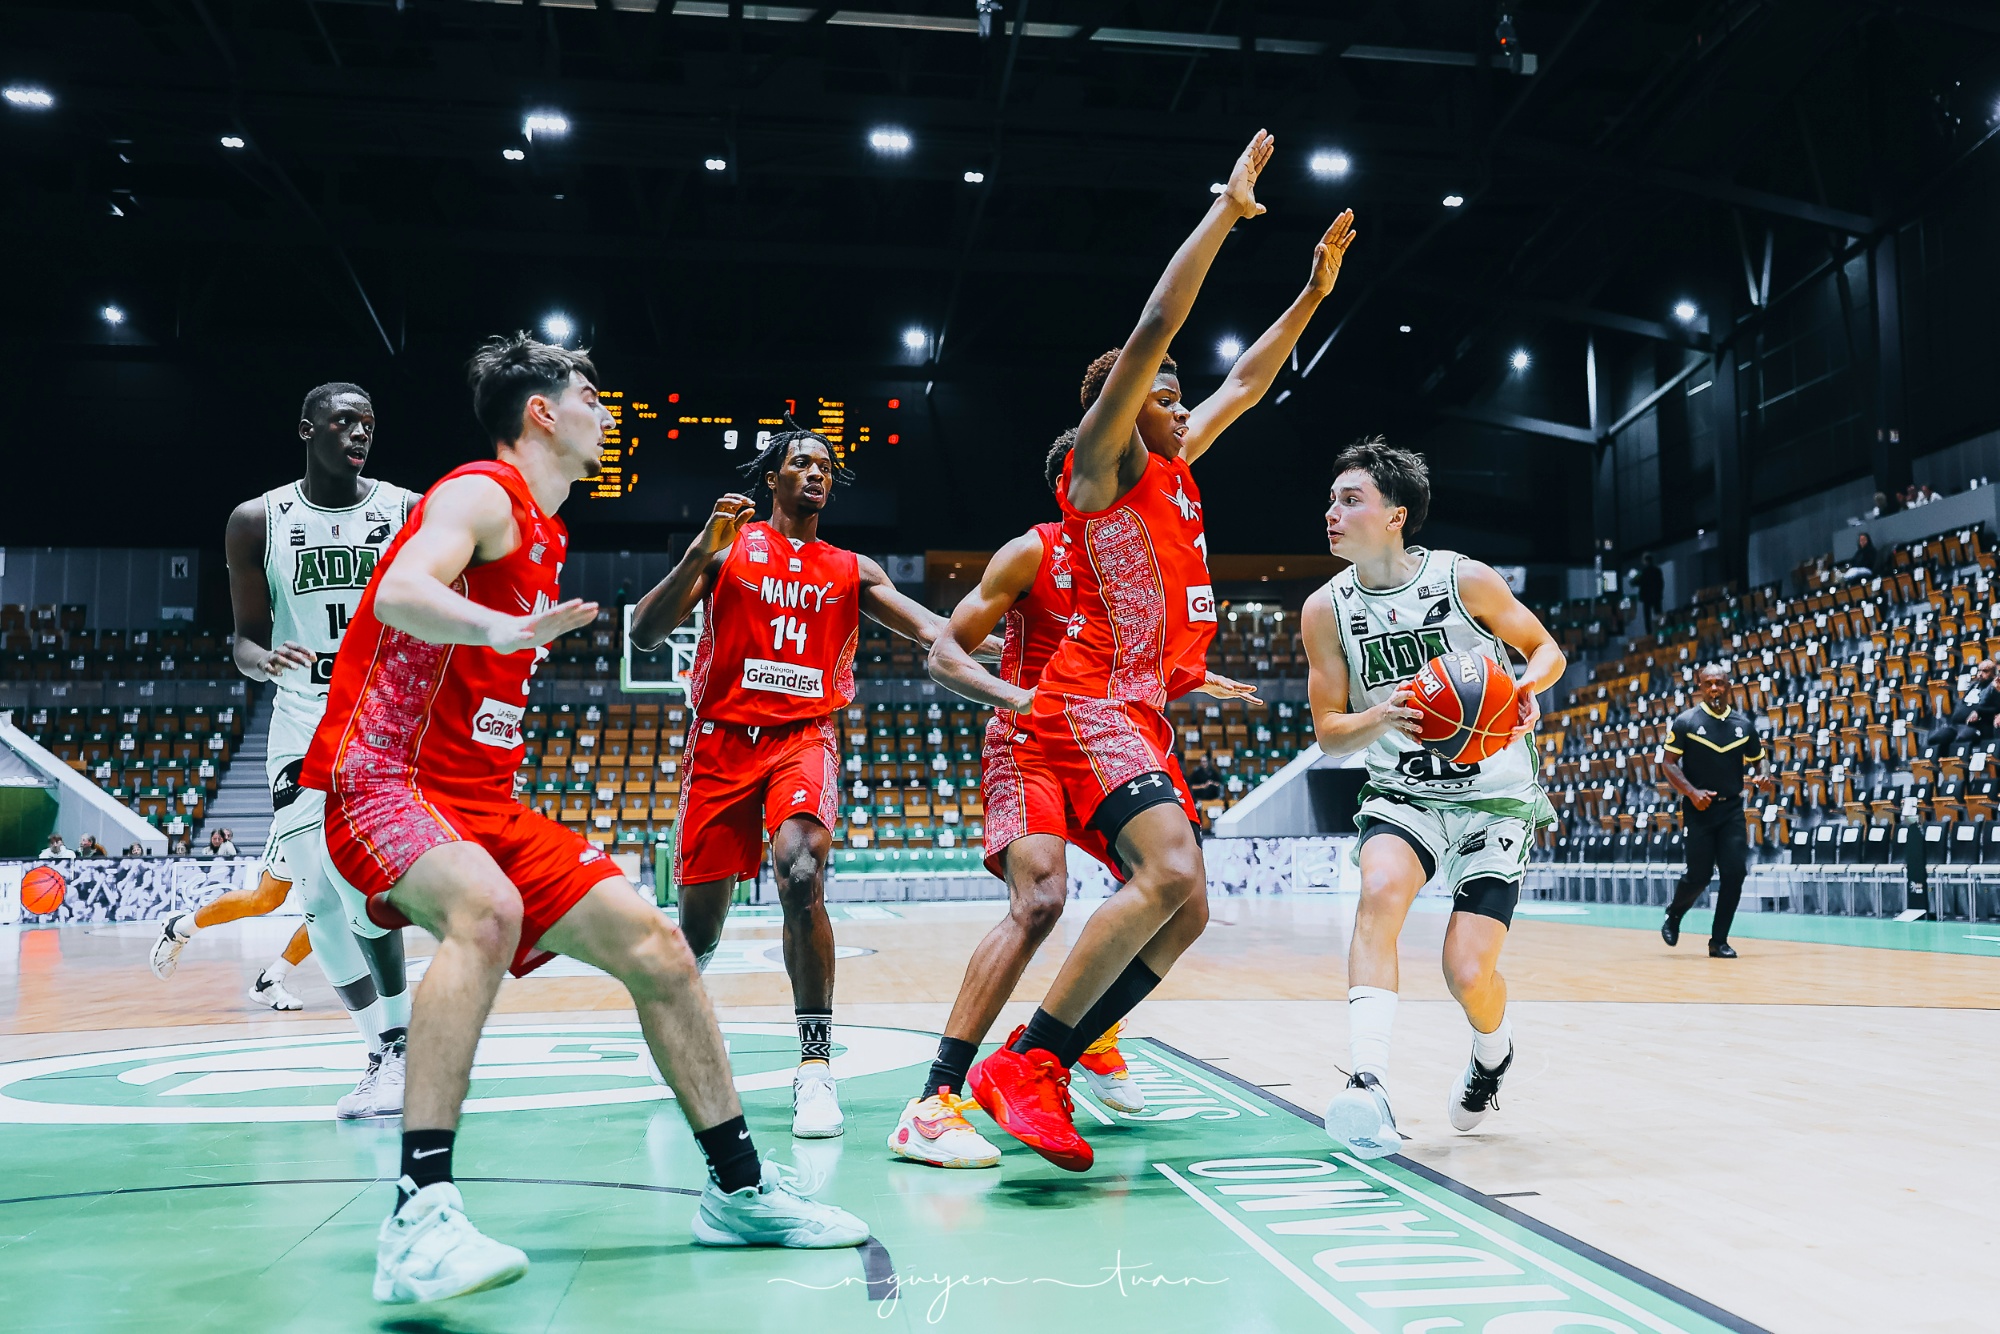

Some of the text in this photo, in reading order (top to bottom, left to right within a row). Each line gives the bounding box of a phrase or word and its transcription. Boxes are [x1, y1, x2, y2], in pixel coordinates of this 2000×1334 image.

[724, 430, 738, 450] 9
[175, 563, 185, 578] K
[293, 546, 379, 595] ADA
[761, 576, 831, 613] NANCY
[770, 615, 807, 654] 14
[1360, 627, 1453, 691] ADA
